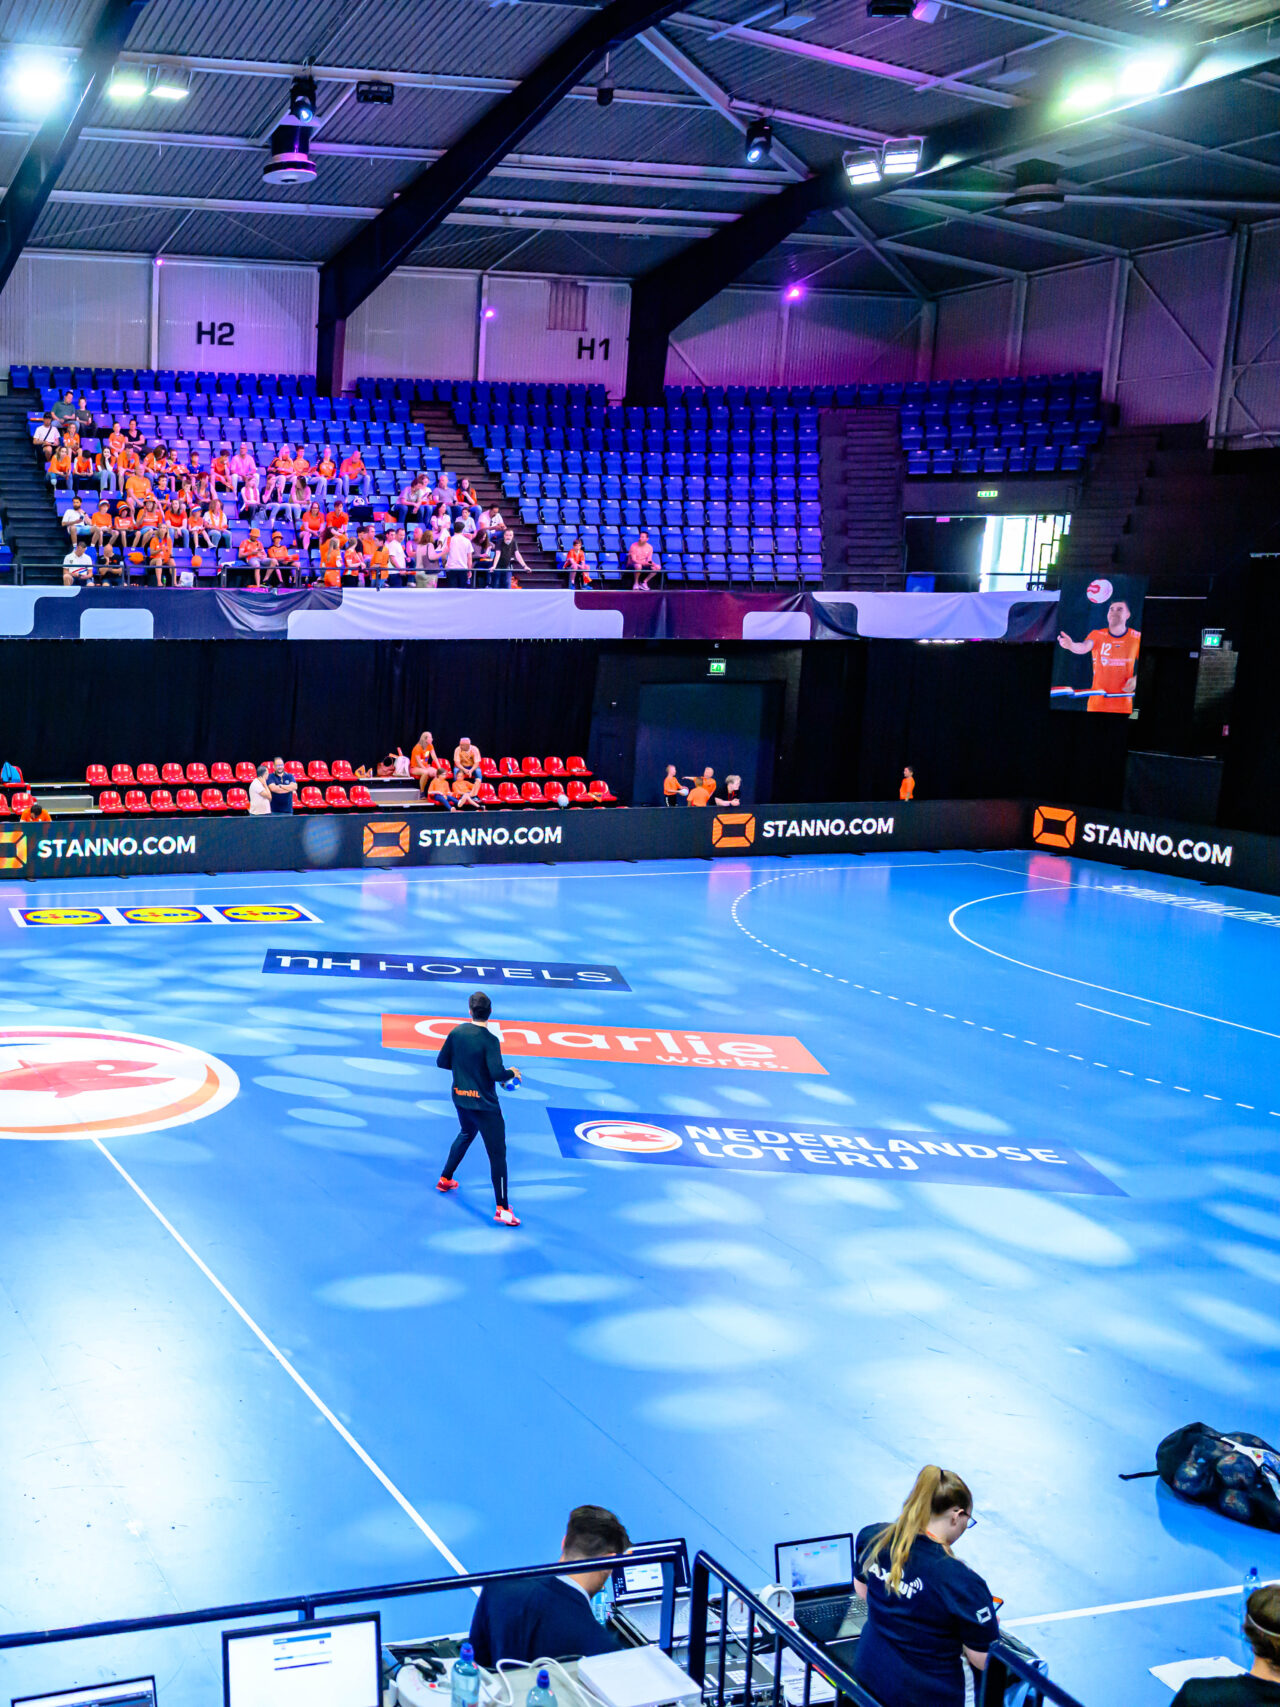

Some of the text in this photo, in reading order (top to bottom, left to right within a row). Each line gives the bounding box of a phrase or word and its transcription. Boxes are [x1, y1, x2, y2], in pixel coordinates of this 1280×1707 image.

[197, 321, 235, 346] H2
[577, 337, 611, 361] H1
[1100, 643, 1112, 655] 12
[418, 825, 562, 848] STANNO.COM
[762, 817, 895, 838] STANNO.COM
[38, 835, 196, 859] STANNO.COM
[1082, 823, 1233, 867] STANNO.COM
[379, 961, 613, 983] HOTELS
[655, 1054, 790, 1071] works.
[684, 1124, 1068, 1165] NEDERLANDSE
[694, 1141, 920, 1171] LOTERIJ
